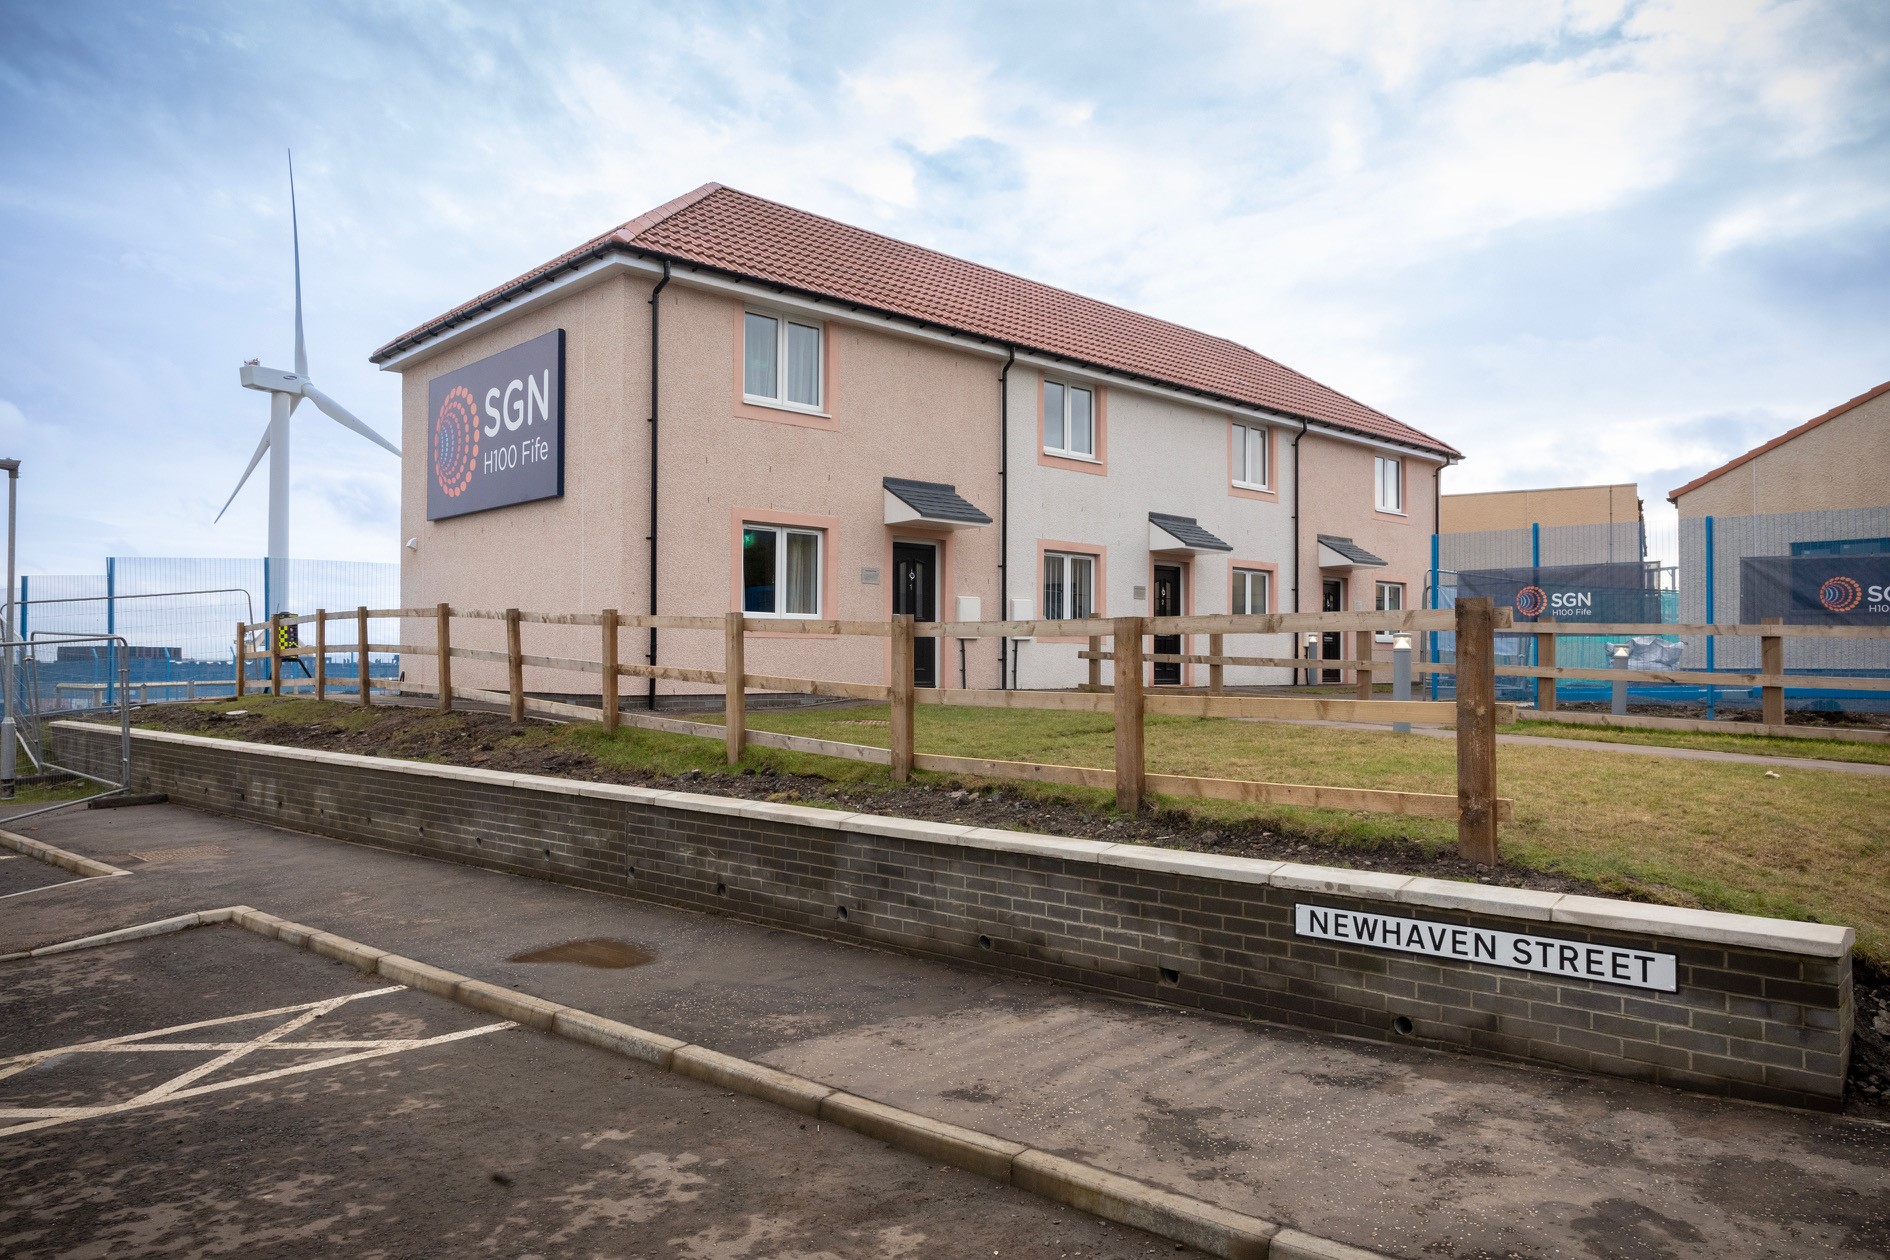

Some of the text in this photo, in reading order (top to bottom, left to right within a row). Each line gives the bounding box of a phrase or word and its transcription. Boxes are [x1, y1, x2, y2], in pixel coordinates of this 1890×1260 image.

[484, 368, 549, 438] SGN
[484, 436, 549, 475] H100 Fife
[1551, 592, 1592, 607] SGN
[1552, 607, 1592, 616] H100 Fife
[1309, 909, 1656, 983] NEWHAVEN STREET
